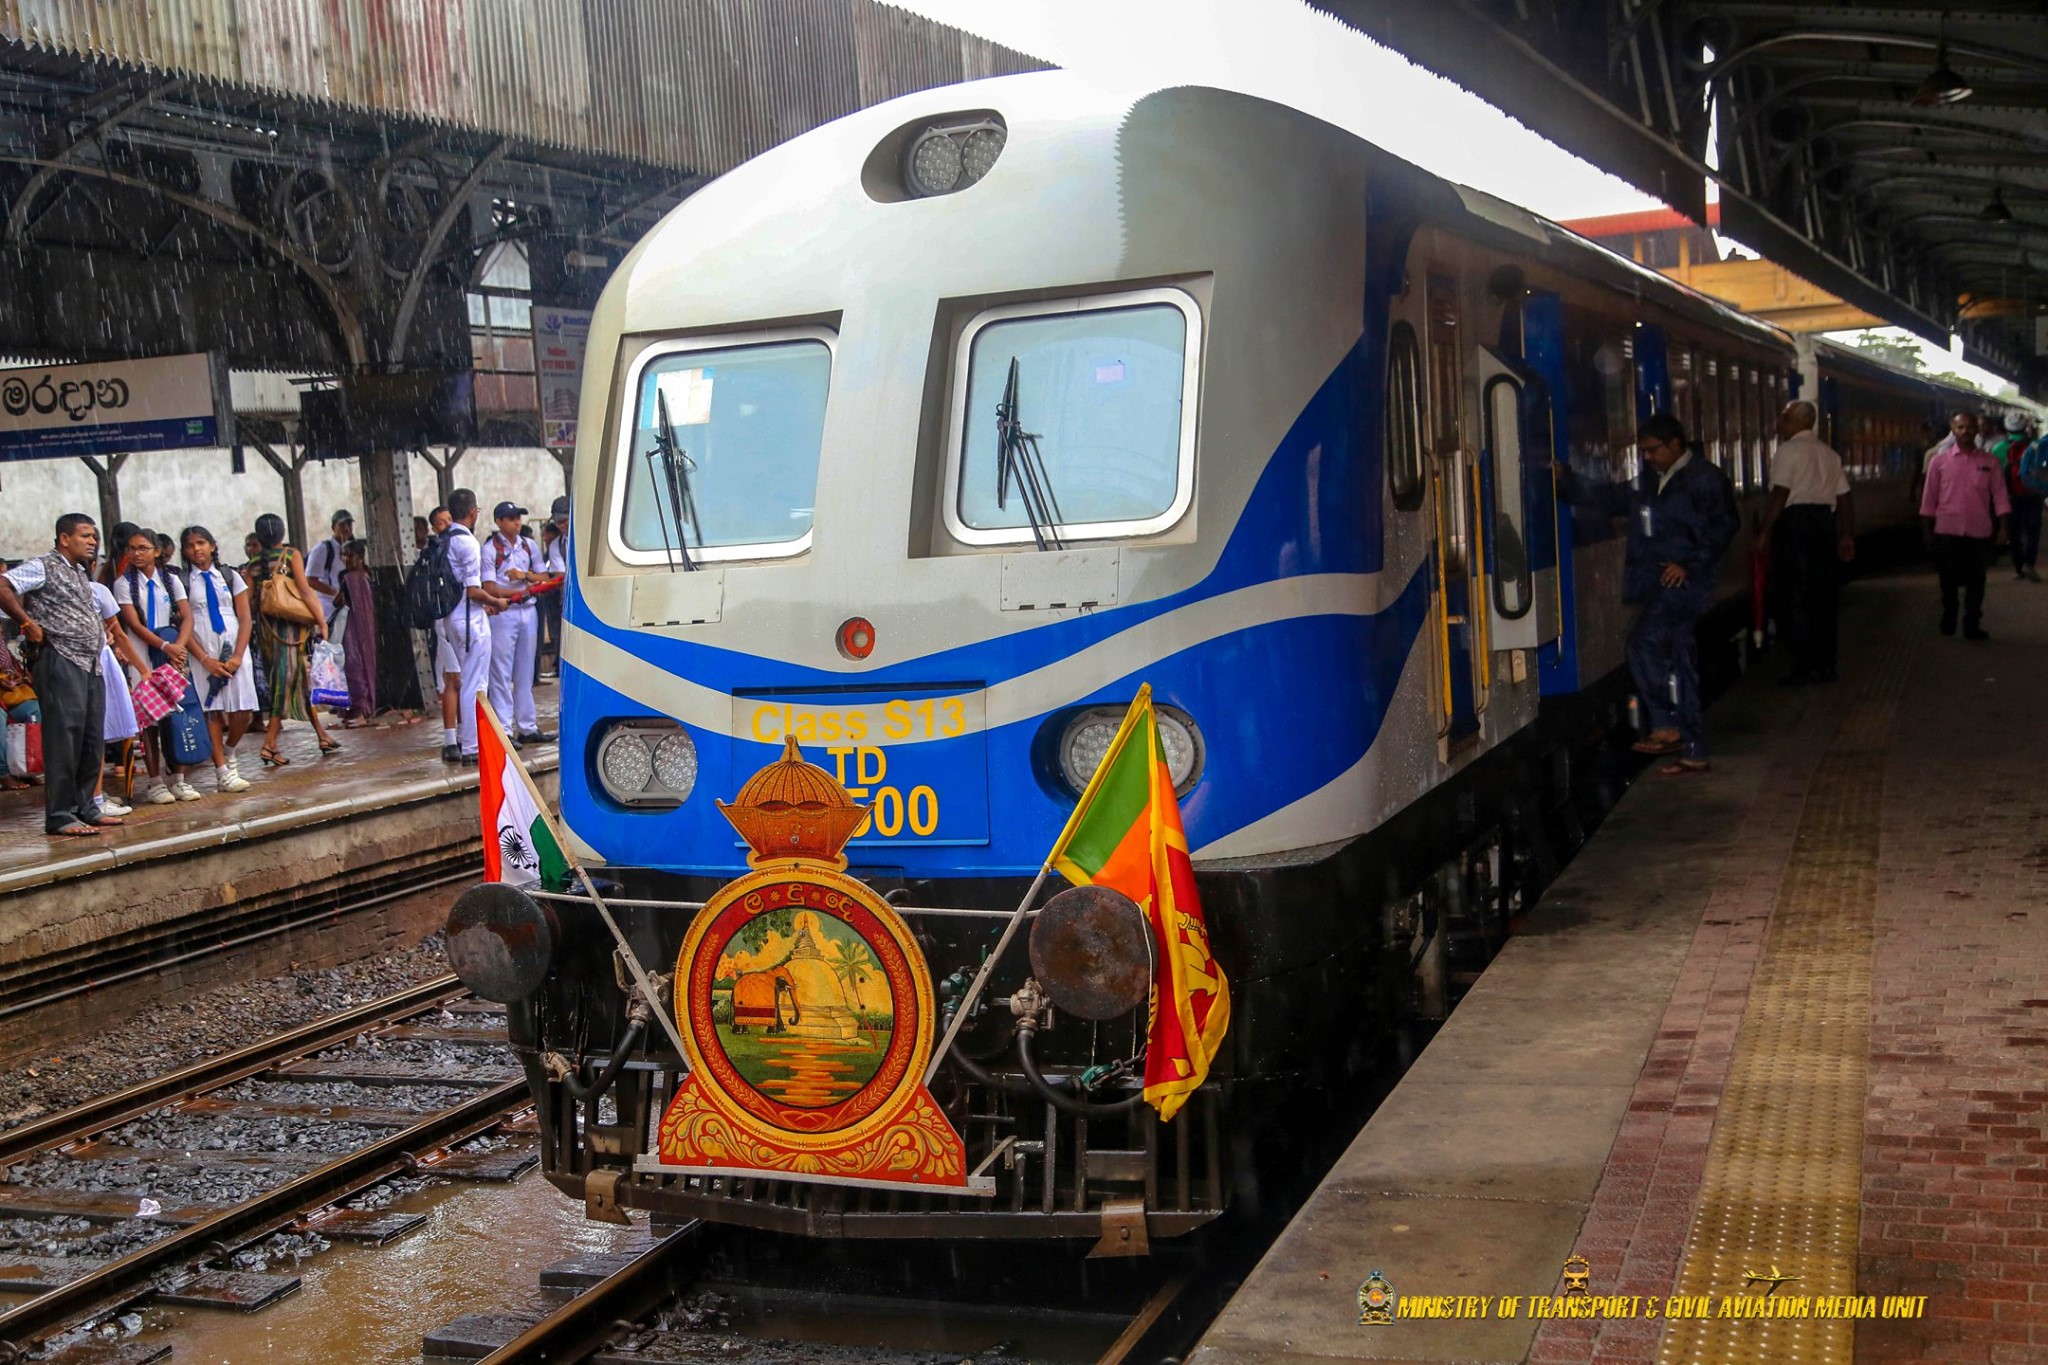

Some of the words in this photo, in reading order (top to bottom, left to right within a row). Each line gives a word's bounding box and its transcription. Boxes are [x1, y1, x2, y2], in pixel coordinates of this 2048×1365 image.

[2, 374, 130, 422] මරදාන
[751, 703, 868, 743] Class
[883, 697, 967, 740] S13
[827, 745, 888, 786] TD
